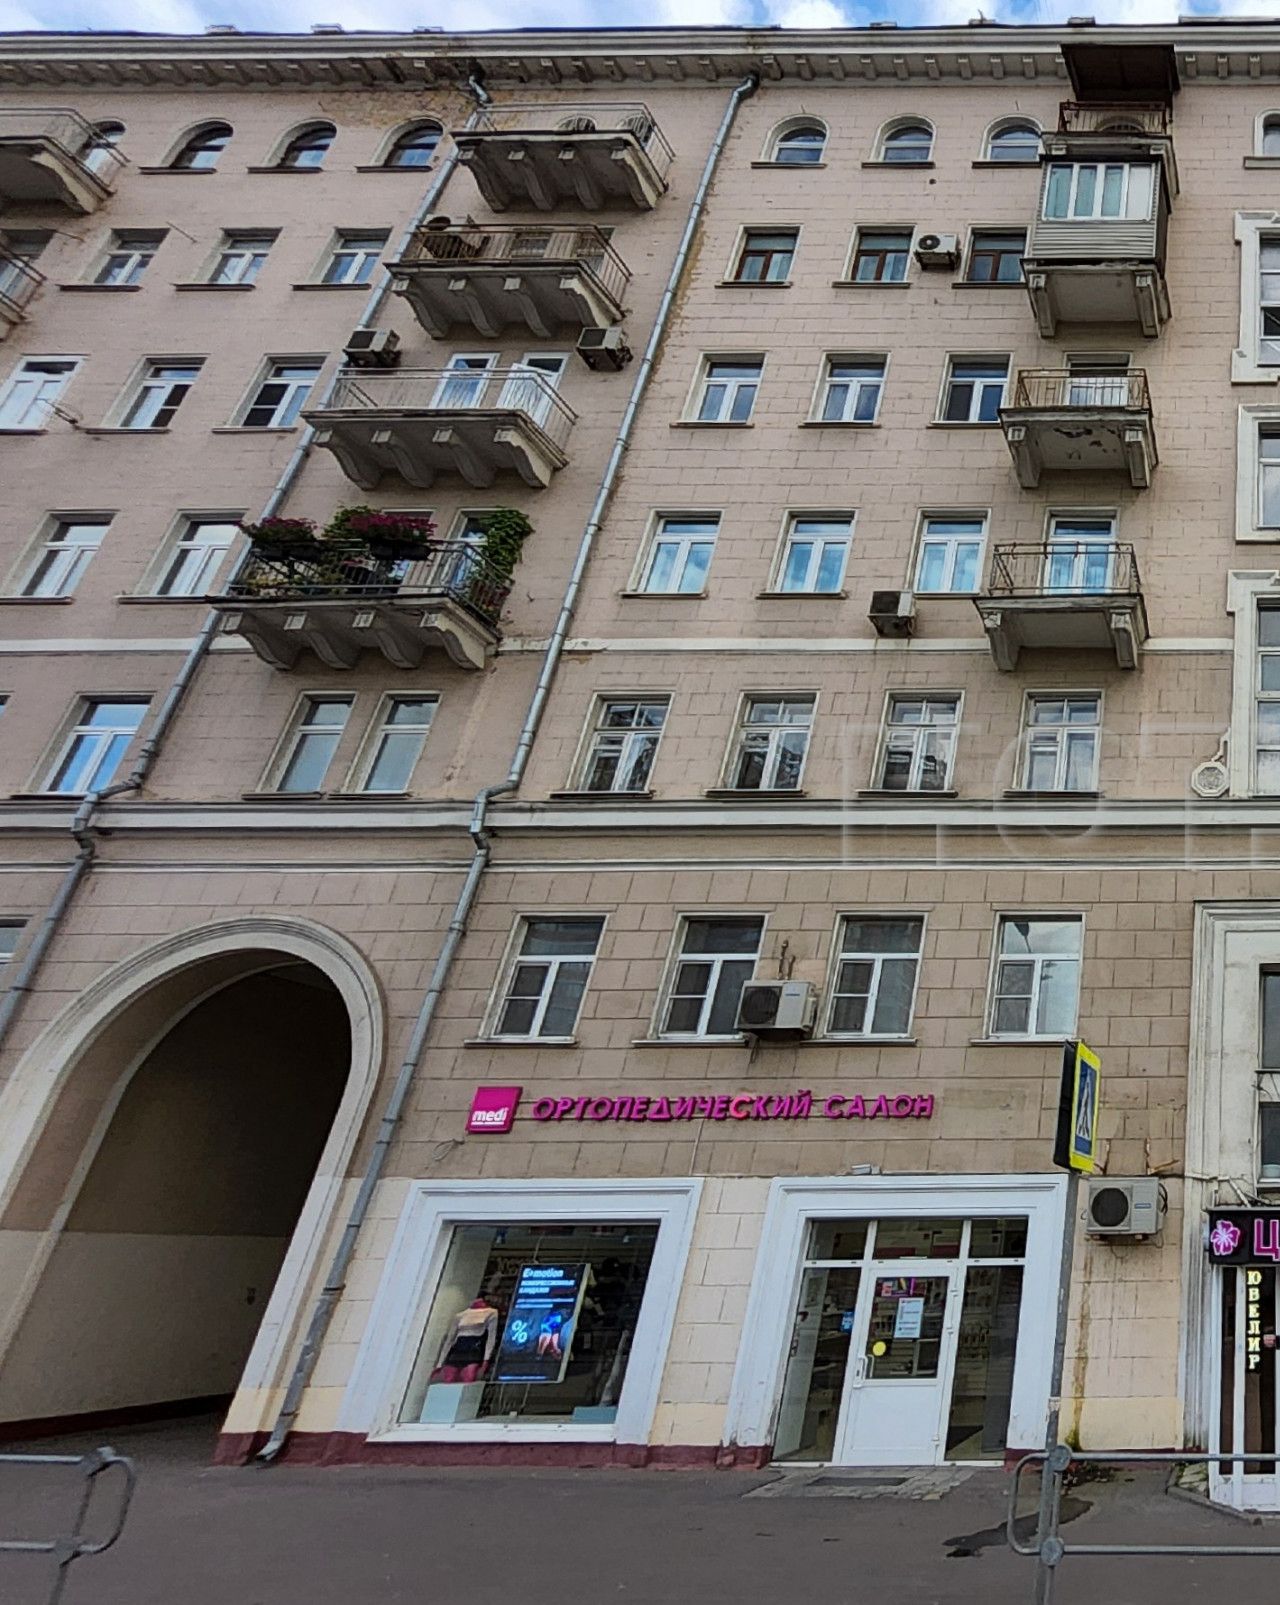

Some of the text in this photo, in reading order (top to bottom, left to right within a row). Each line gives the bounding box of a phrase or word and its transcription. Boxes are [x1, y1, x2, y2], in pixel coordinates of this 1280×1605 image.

[471, 1107, 509, 1122] medi
[533, 1090, 934, 1121] ОРТОПЕДИЧЕСКИЙ САЛОН
[1247, 1270, 1262, 1370] ЮВЕЛИР
